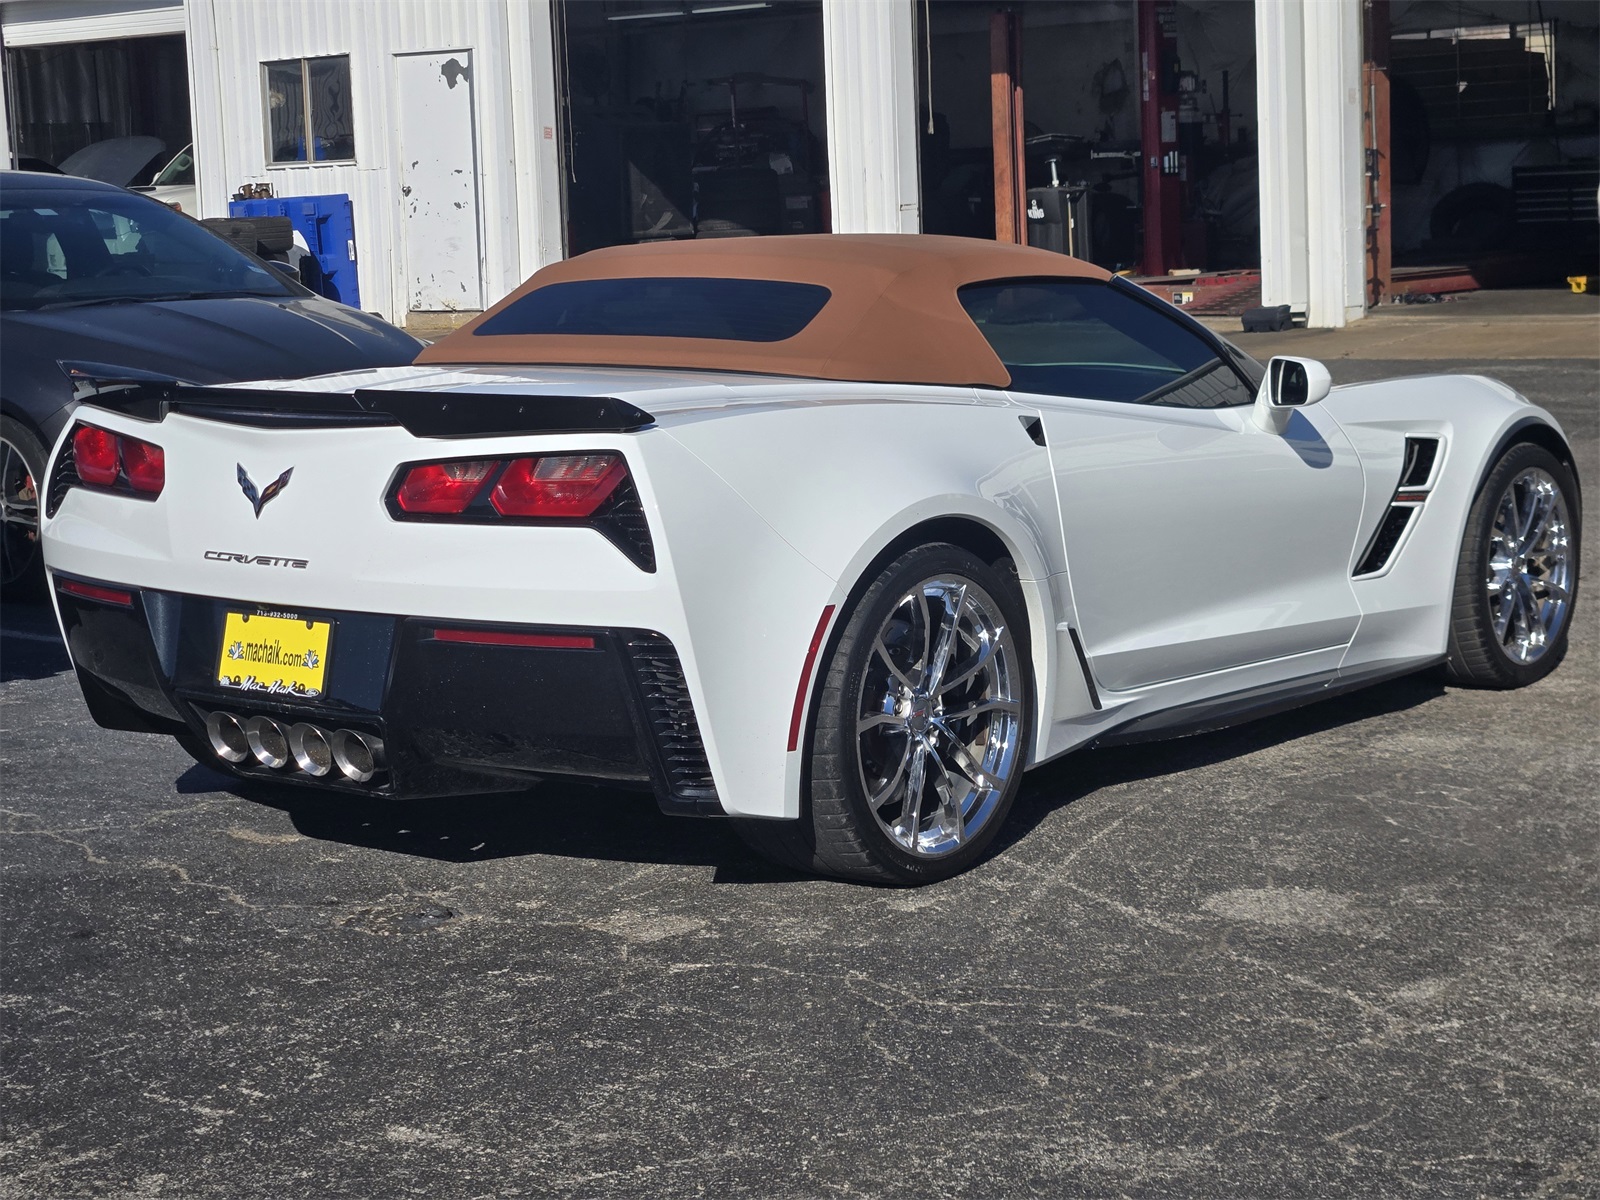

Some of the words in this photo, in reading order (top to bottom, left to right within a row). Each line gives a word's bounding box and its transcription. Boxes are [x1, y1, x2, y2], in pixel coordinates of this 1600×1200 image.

[204, 550, 309, 569] CORVETTE
[244, 639, 301, 668] machaik.com
[239, 675, 266, 691] Mac
